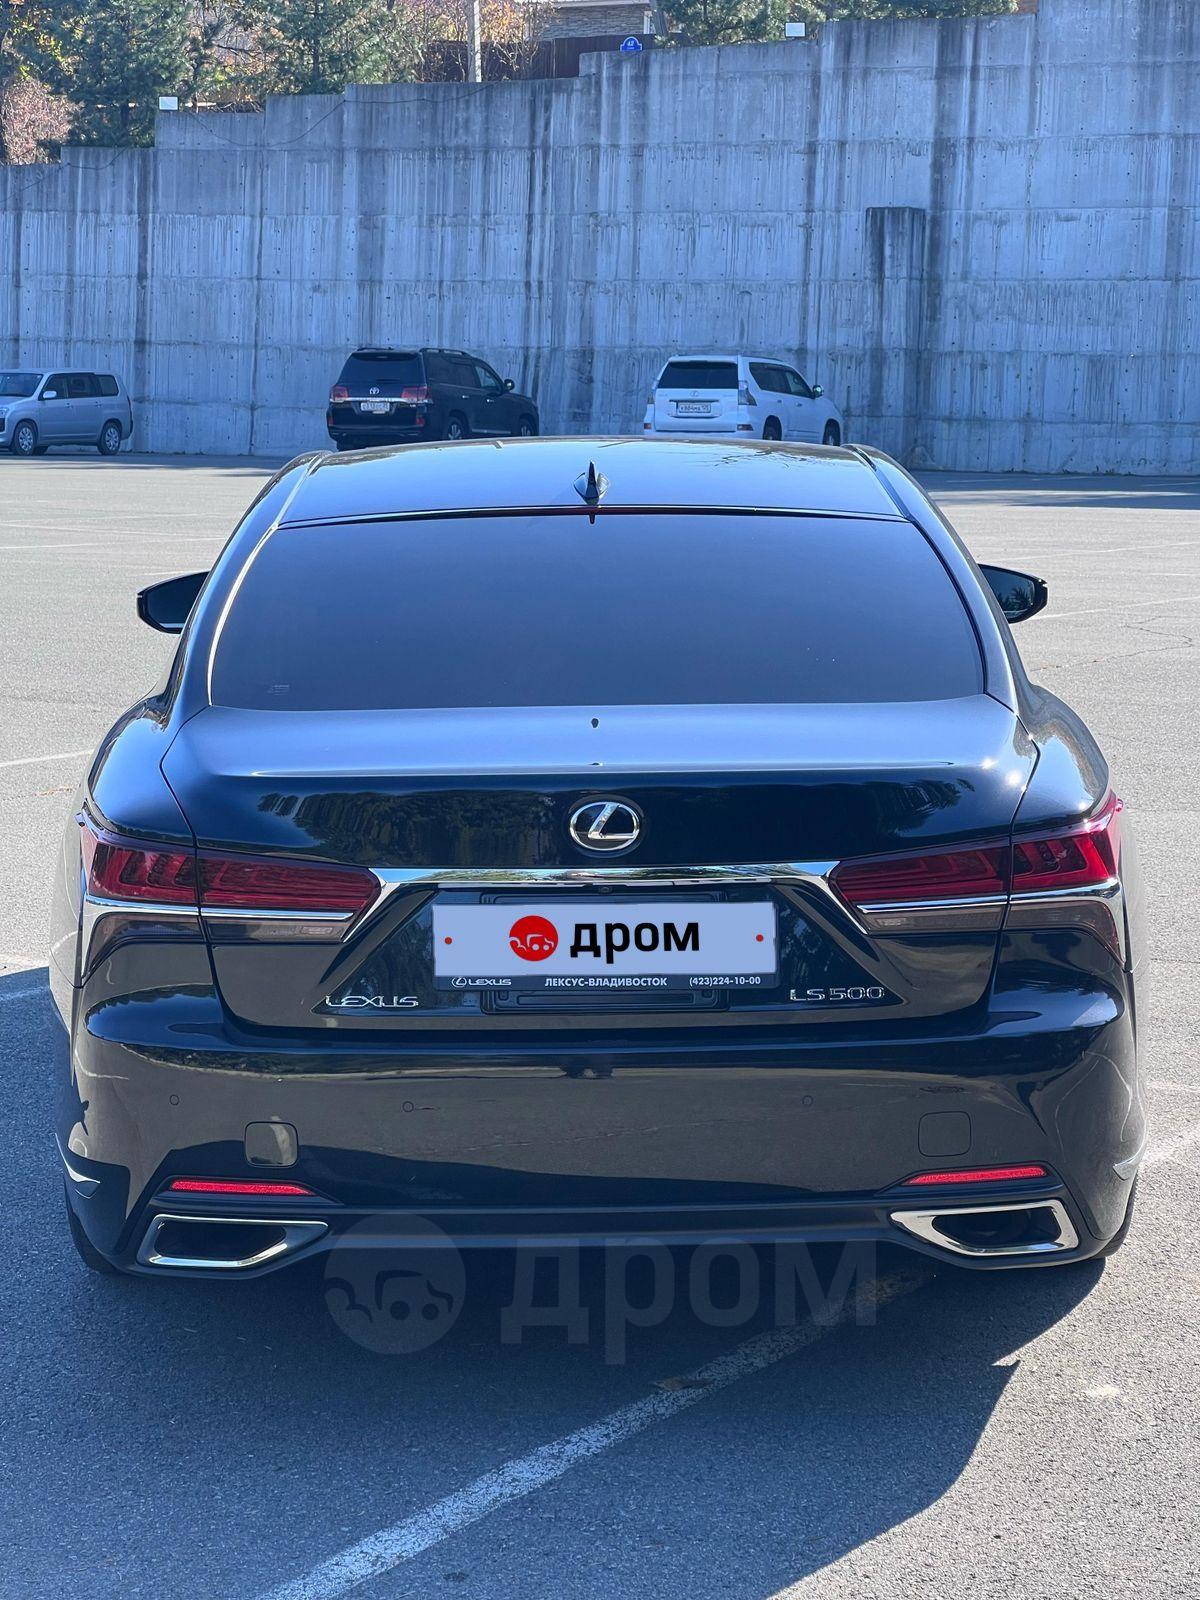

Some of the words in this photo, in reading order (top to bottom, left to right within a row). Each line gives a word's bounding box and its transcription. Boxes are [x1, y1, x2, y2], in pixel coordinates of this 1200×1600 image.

[467, 978, 512, 986] LEXUS
[544, 977, 668, 988] ЛЕКСУС-ВЛАДИВОСТОК
[689, 976, 762, 987] (423)224-10-00
[789, 988, 826, 1001] LS
[829, 986, 886, 1001] 500
[325, 995, 420, 1008] LEXUS
